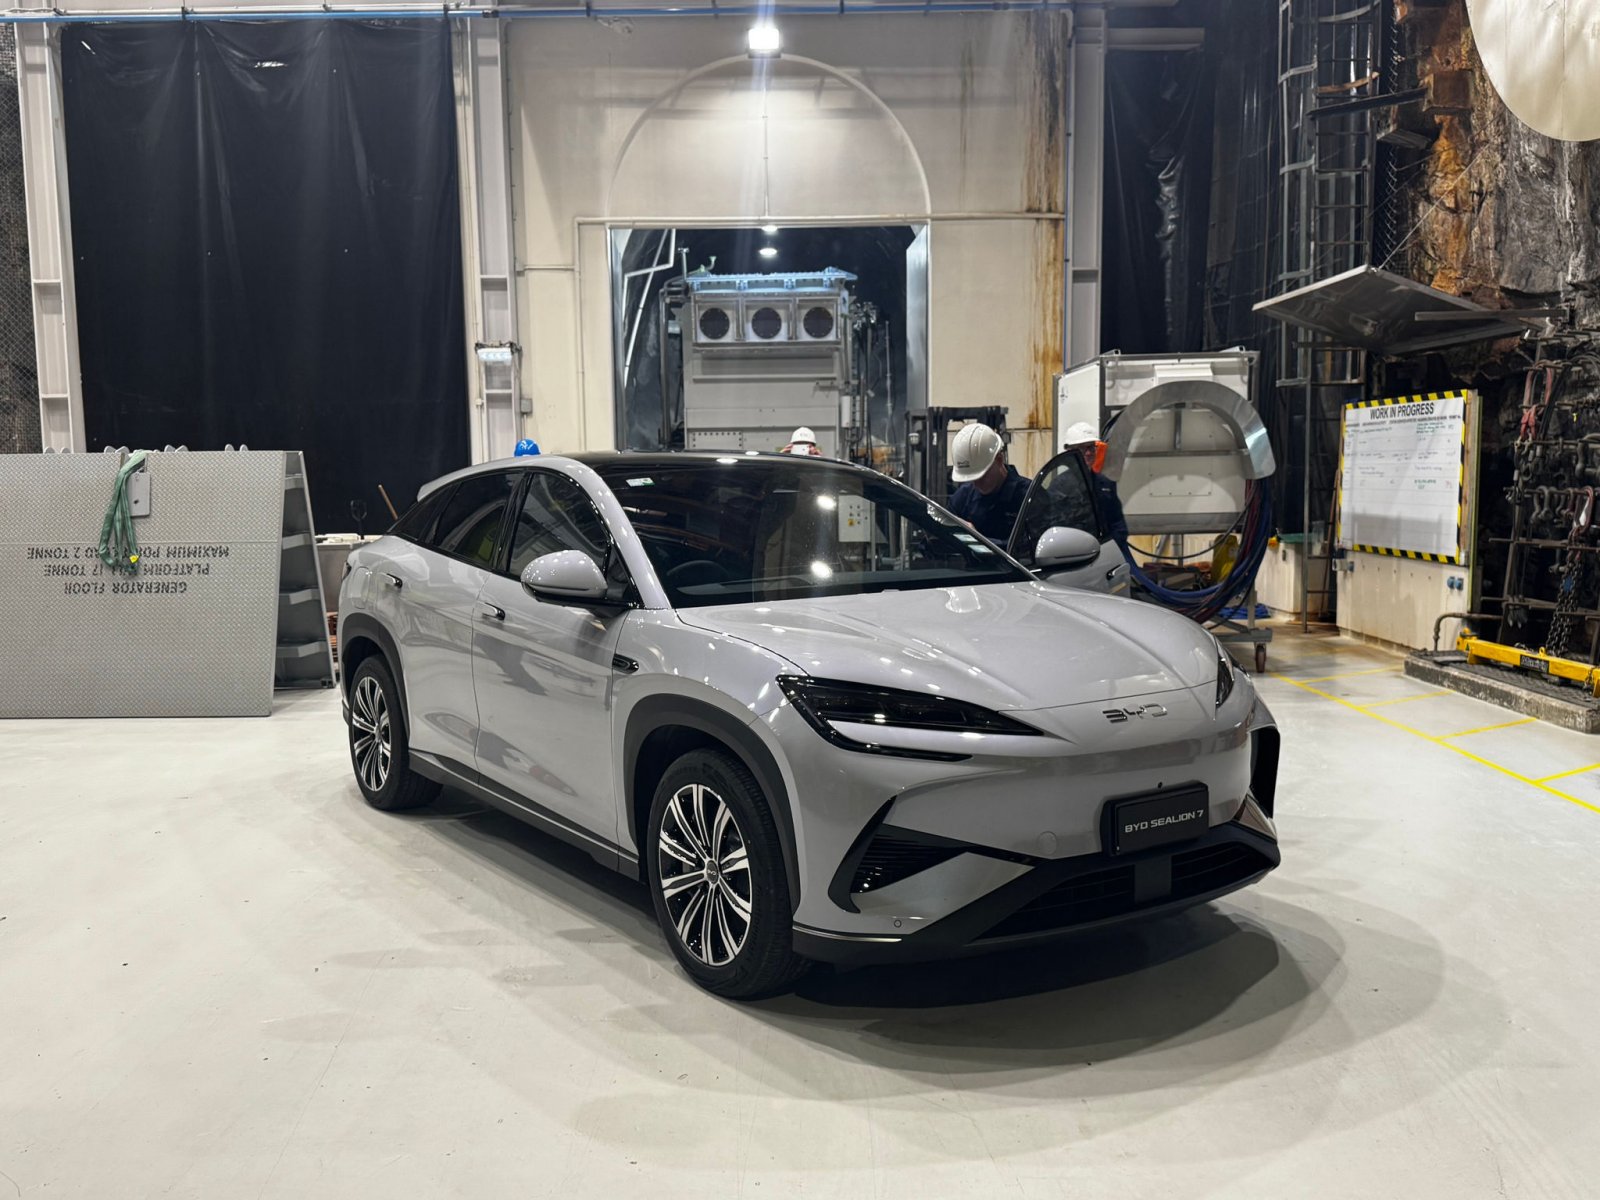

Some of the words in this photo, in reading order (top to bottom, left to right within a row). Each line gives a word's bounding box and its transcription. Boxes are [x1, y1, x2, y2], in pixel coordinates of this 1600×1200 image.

[1370, 407, 1389, 420] WORK
[1390, 406, 1397, 418] IN
[1397, 402, 1435, 417] PROGRESS
[26, 547, 69, 559] TONNE
[73, 547, 81, 559] 2
[166, 546, 230, 559] MAXIMUM
[43, 564, 87, 577] TONNE
[143, 563, 210, 576] PLATFORM
[64, 582, 106, 594] FLOOR
[112, 581, 187, 594] GENERATOR
[1102, 703, 1168, 723] BYD
[1124, 821, 1148, 833] BYD
[1150, 812, 1195, 828] SEALION
[1195, 809, 1204, 817] 7
